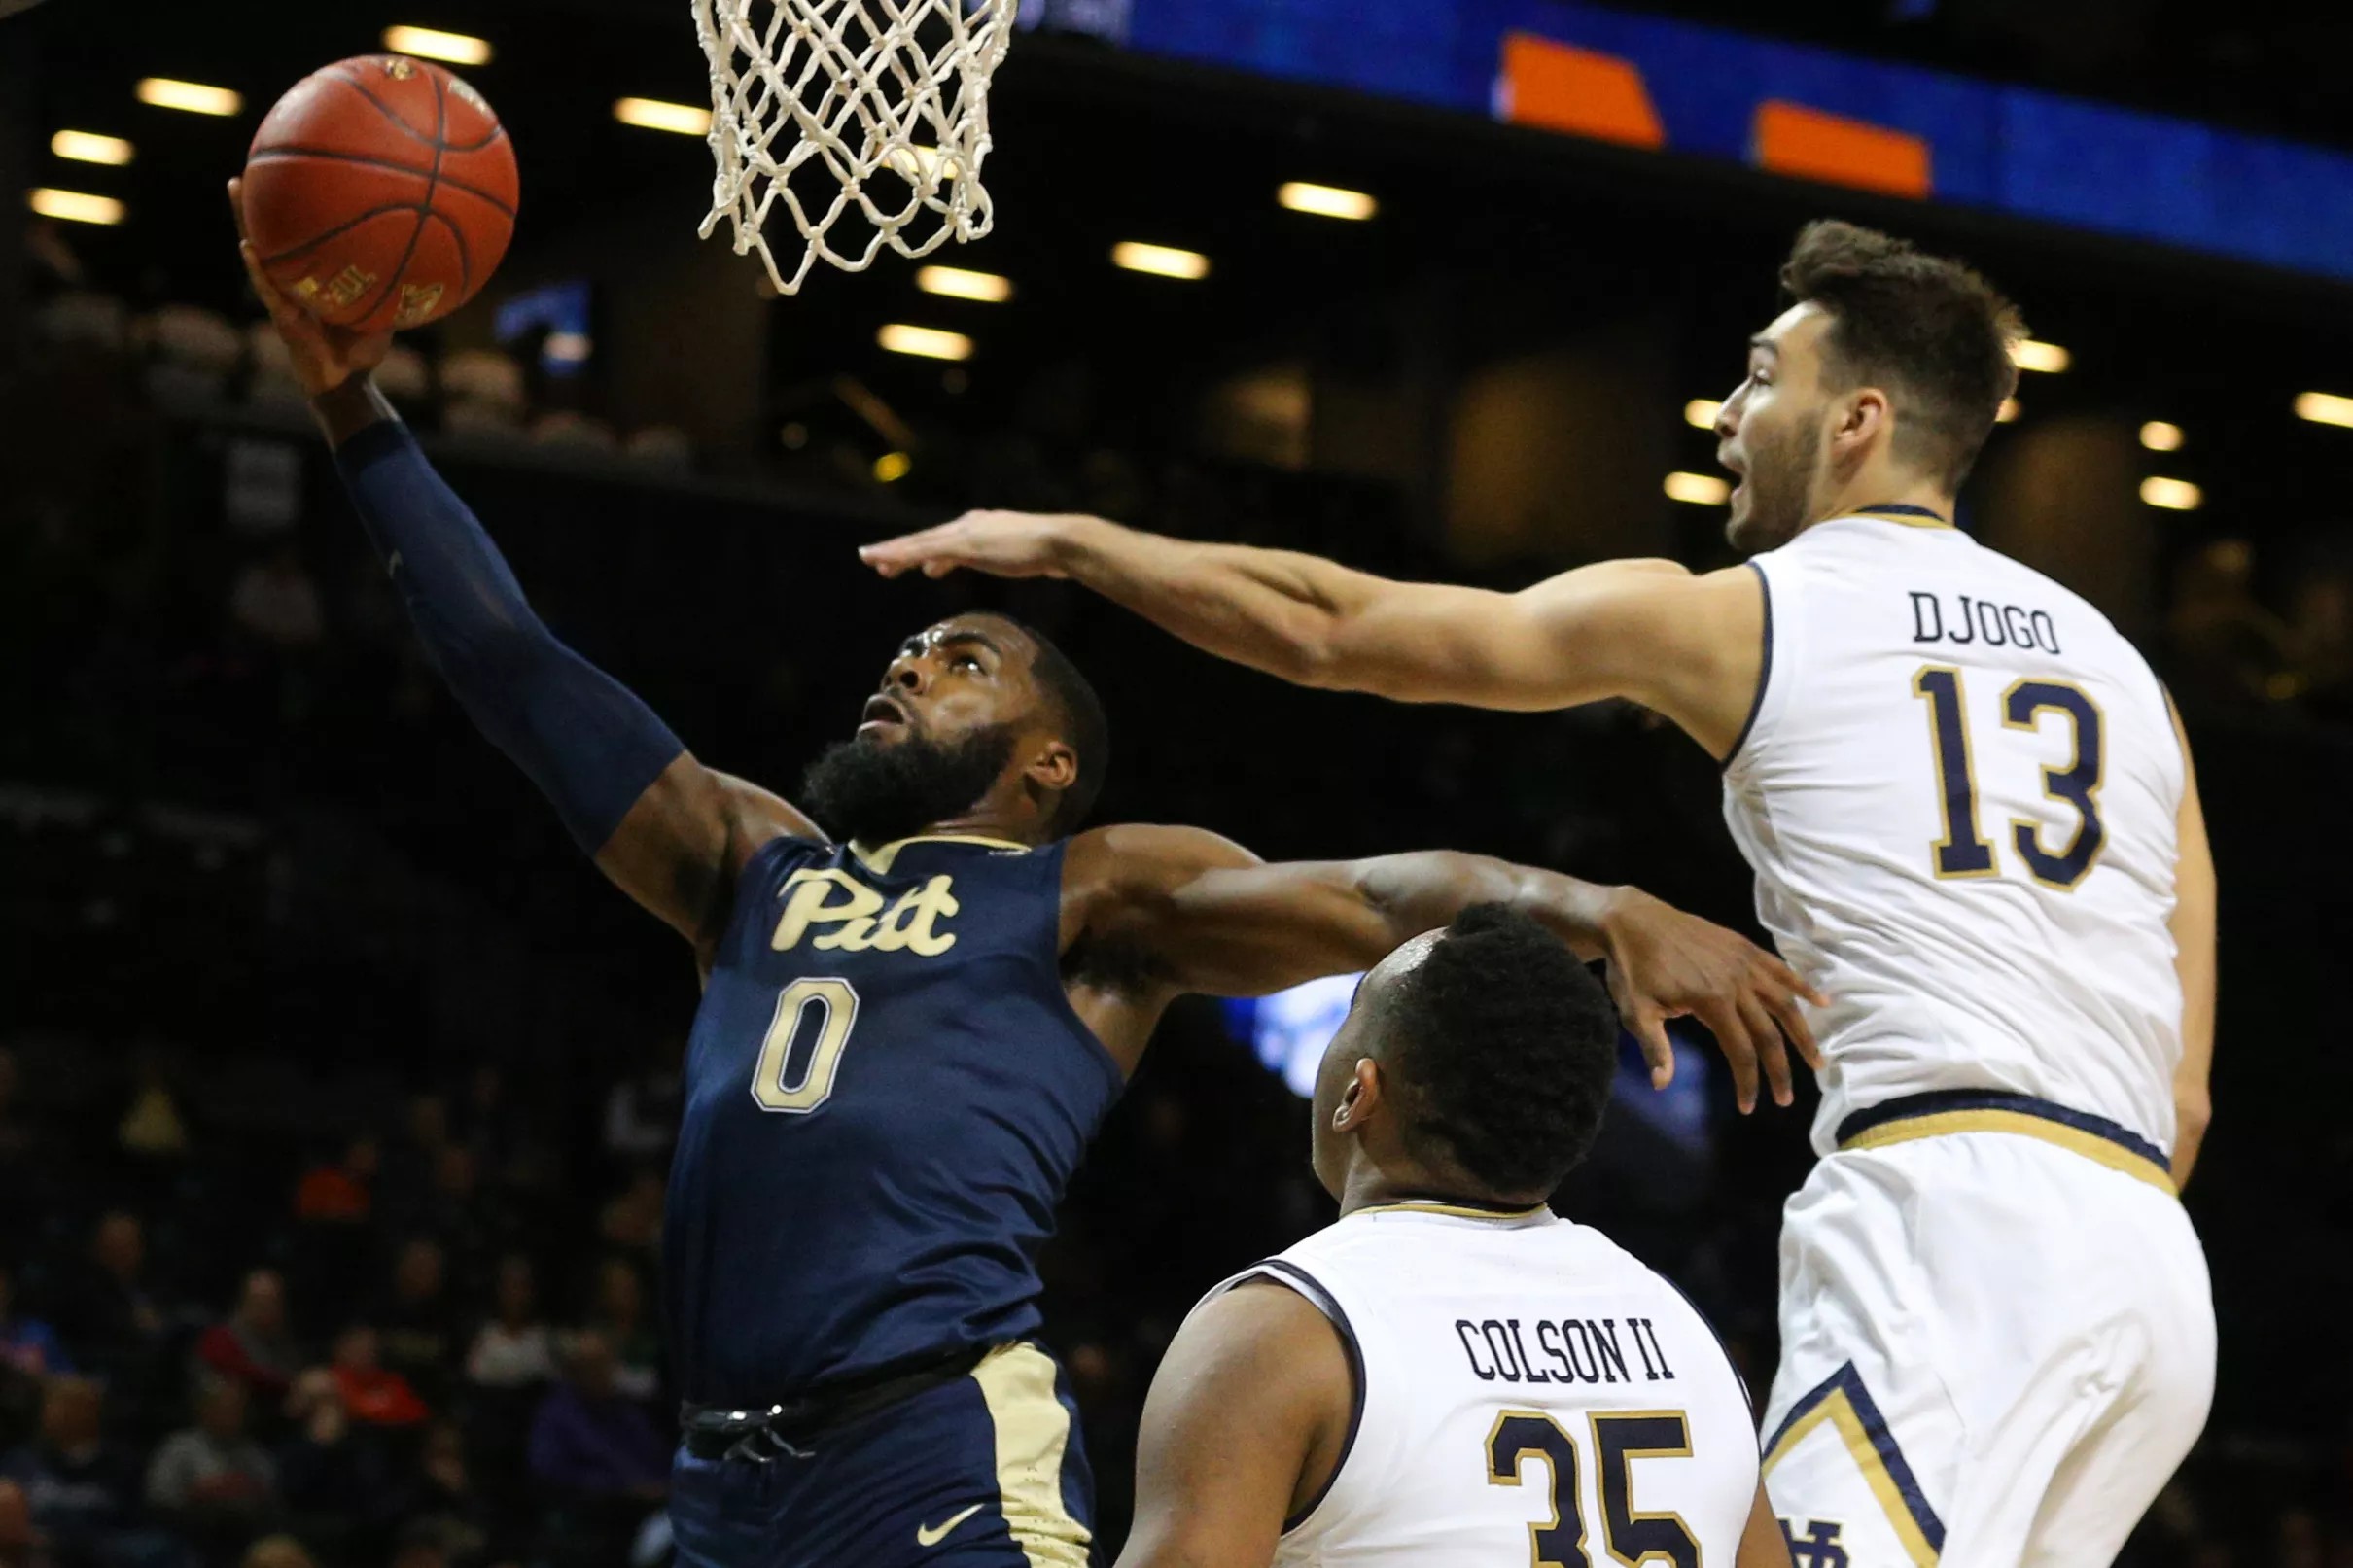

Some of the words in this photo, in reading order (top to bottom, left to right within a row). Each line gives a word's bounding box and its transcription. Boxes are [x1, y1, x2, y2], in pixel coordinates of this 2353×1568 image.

[1908, 591, 2061, 655] DJOGO
[1911, 664, 2108, 893] 13
[771, 868, 960, 957] Pitt
[750, 976, 860, 1114] 0
[1456, 1318, 1632, 1383] COLSON
[1626, 1317, 1676, 1380] II
[1484, 1409, 1703, 1568] 35
